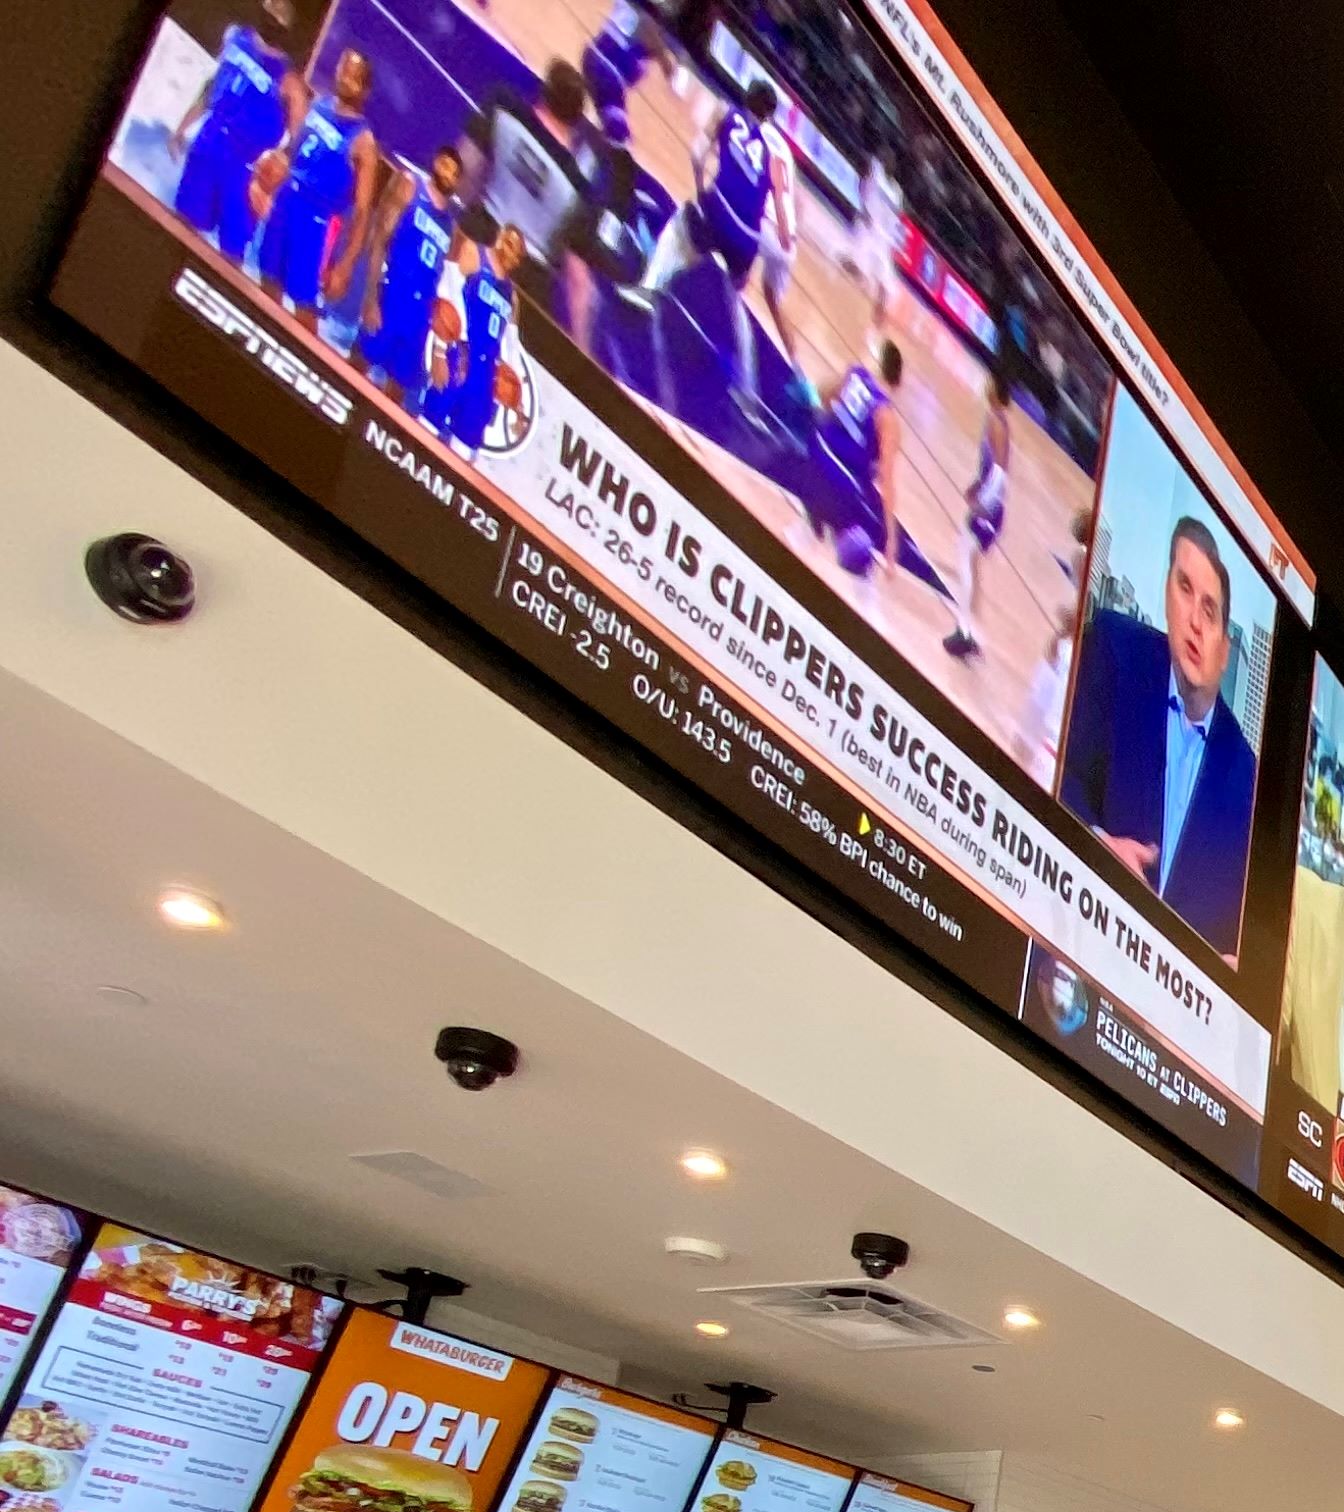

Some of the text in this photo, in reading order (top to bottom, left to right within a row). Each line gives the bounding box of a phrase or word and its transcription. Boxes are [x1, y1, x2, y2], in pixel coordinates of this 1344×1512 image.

[950, 91, 1021, 196] Rushmore
[1021, 196, 1050, 238] with
[1051, 240, 1073, 273] 3rd
[1073, 270, 1109, 325] Super
[1111, 322, 1141, 368] Bowl
[1140, 363, 1170, 407] title?
[365, 420, 500, 542] NCAAM T25
[518, 542, 928, 881] 19 Creighton vs Providence 8:30 ET
[544, 477, 1028, 900] LAC: 26-5 record since Dec. 1 (best in NBA during span)
[560, 421, 1214, 1026] WHO IS CLIPPERS SUCCESS RIDING ON THE MOST?
[512, 579, 964, 942] CREI -2.5 O/U: 143.5 CREI: 58% BPI chance to win
[1096, 1036, 1135, 1072] TONIGHT
[1096, 1009, 1228, 1128] PELICANS AT CLIPPERS
[1287, 1157, 1324, 1202] ESPN
[1297, 1110, 1323, 1148] SC
[170, 1275, 259, 1316] PARRY'S
[398, 1329, 507, 1375] WHATABURGER
[337, 1381, 500, 1472] OPEN
